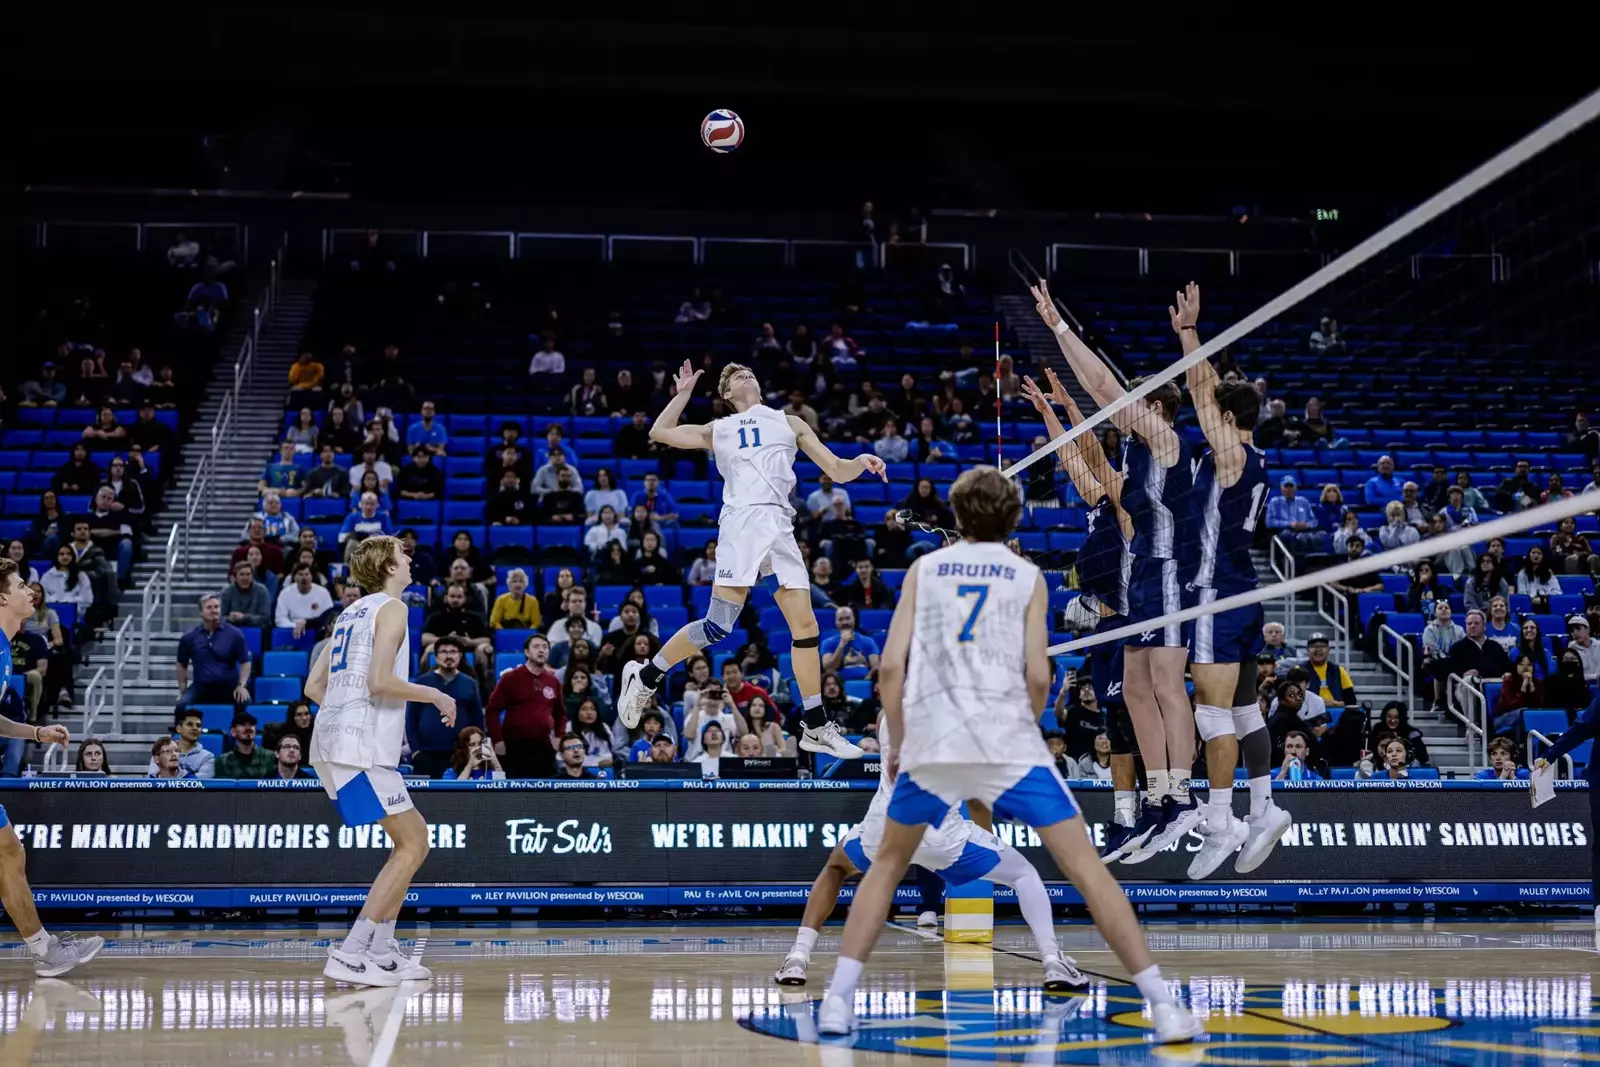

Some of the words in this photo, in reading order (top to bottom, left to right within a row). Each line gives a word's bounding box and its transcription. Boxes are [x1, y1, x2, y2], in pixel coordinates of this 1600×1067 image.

[1316, 208, 1339, 221] EXIT
[737, 426, 763, 450] 11
[937, 562, 1016, 581] BRUINS
[956, 583, 991, 643] 7
[330, 624, 355, 674] 21
[64, 780, 108, 789] PAVILION
[257, 780, 290, 788] PAULEY
[292, 780, 323, 788] PAVILI
[759, 781, 800, 789] presented
[814, 780, 850, 789] WESCOM
[1284, 780, 1313, 789] PAULEY
[1316, 780, 1355, 789] PAVILION
[1356, 780, 1395, 789] presented
[1397, 780, 1407, 790] by
[1409, 780, 1443, 789] WESCOM
[387, 792, 406, 807] Ucla
[14, 823, 64, 849] E'RE
[71, 823, 160, 849] MAKIN'
[167, 823, 330, 849] SANDWICHES
[427, 823, 467, 849] ERE
[505, 818, 554, 854] Fat
[553, 818, 613, 854] Sal's
[651, 823, 724, 848] WE'RE
[731, 823, 814, 848] MAKIN'
[1280, 823, 1347, 847] WE'RE
[1354, 822, 1431, 846] MAKIN'
[1439, 822, 1587, 846] SANDWICHES
[506, 891, 548, 899] PAVILION
[550, 891, 592, 901] presented
[594, 891, 606, 902] by
[606, 891, 644, 900] WESCOM
[762, 889, 803, 899] presented
[1137, 888, 1176, 897] PAVILION
[1220, 888, 1231, 899] by
[1232, 888, 1267, 897] WESCOM
[1372, 886, 1411, 896] presented
[1413, 886, 1424, 897] by
[1425, 886, 1460, 895] WESCOM
[1519, 887, 1550, 896] PAULEY
[1551, 887, 1590, 895] PAVILION
[51, 893, 94, 901] PAVILION
[97, 893, 139, 903] presented
[142, 893, 154, 904] by
[155, 894, 194, 902] WESCOM
[250, 893, 283, 902] PAULEY
[331, 893, 367, 903] presente
